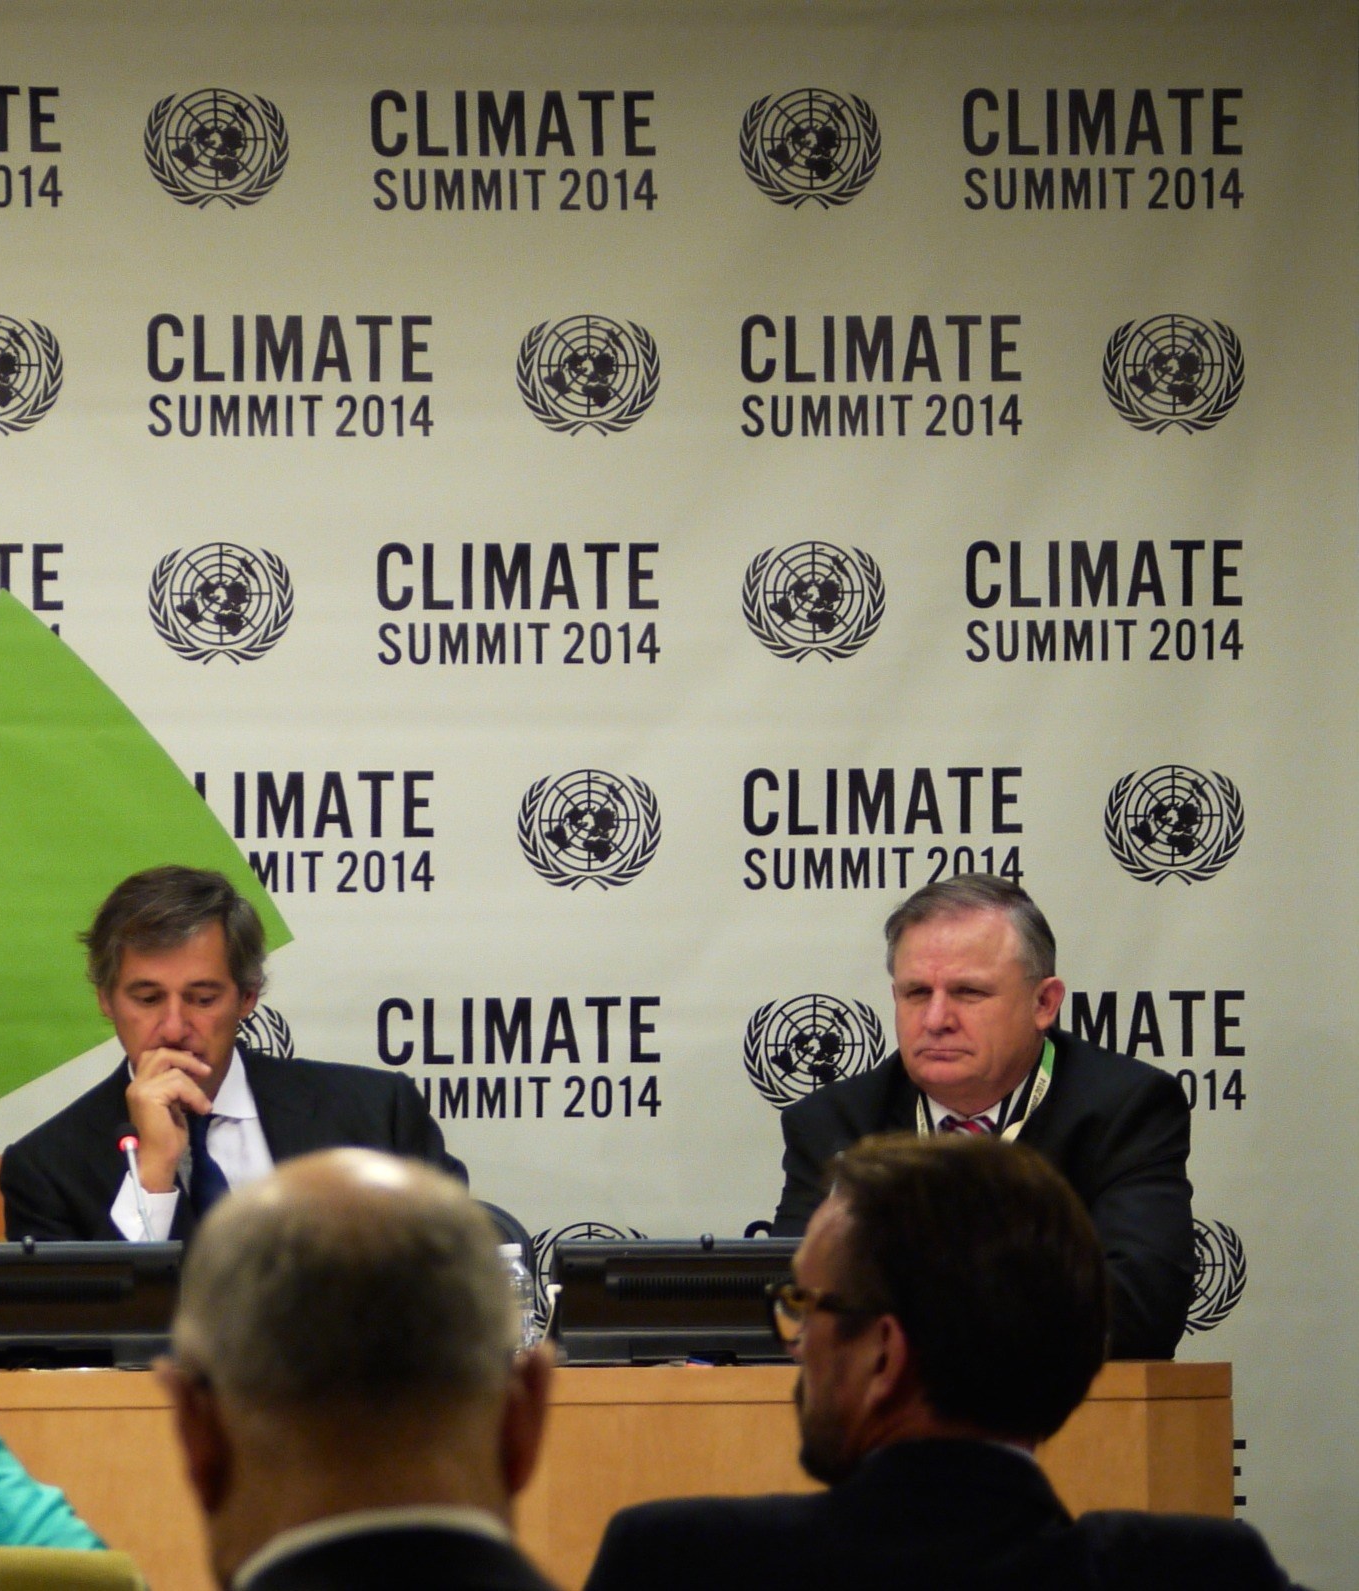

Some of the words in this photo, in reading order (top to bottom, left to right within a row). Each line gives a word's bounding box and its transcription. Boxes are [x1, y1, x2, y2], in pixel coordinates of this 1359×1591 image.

[371, 90, 655, 157] CLIMATE
[963, 88, 1243, 156] CLIMATE
[374, 169, 546, 211] SUMMIT
[560, 169, 657, 211] 2014
[965, 167, 1135, 210] SUMMIT
[1148, 167, 1244, 210] 2014
[148, 314, 432, 382] CLIMATE
[741, 315, 1021, 383] CLIMATE
[149, 394, 323, 437] SUMMIT
[336, 394, 433, 437] 2014
[742, 394, 912, 437] SUMMIT
[926, 394, 1022, 437] 2014
[377, 543, 659, 611] CLIMATE
[966, 540, 1242, 608] CLIMATE
[379, 622, 550, 665] SUMMIT
[564, 622, 660, 665] 2014
[967, 619, 1137, 662] SUMMIT
[1150, 619, 1243, 662] 2014
[194, 771, 434, 838] IMATE
[744, 767, 1022, 836] CLIMATE
[337, 850, 434, 892] 2014
[744, 847, 914, 890] SUMMIT
[926, 846, 1024, 885] 2014
[378, 997, 660, 1066] CLIMATE
[564, 1075, 661, 1118] 2014
[1176, 1068, 1246, 1110] 014
